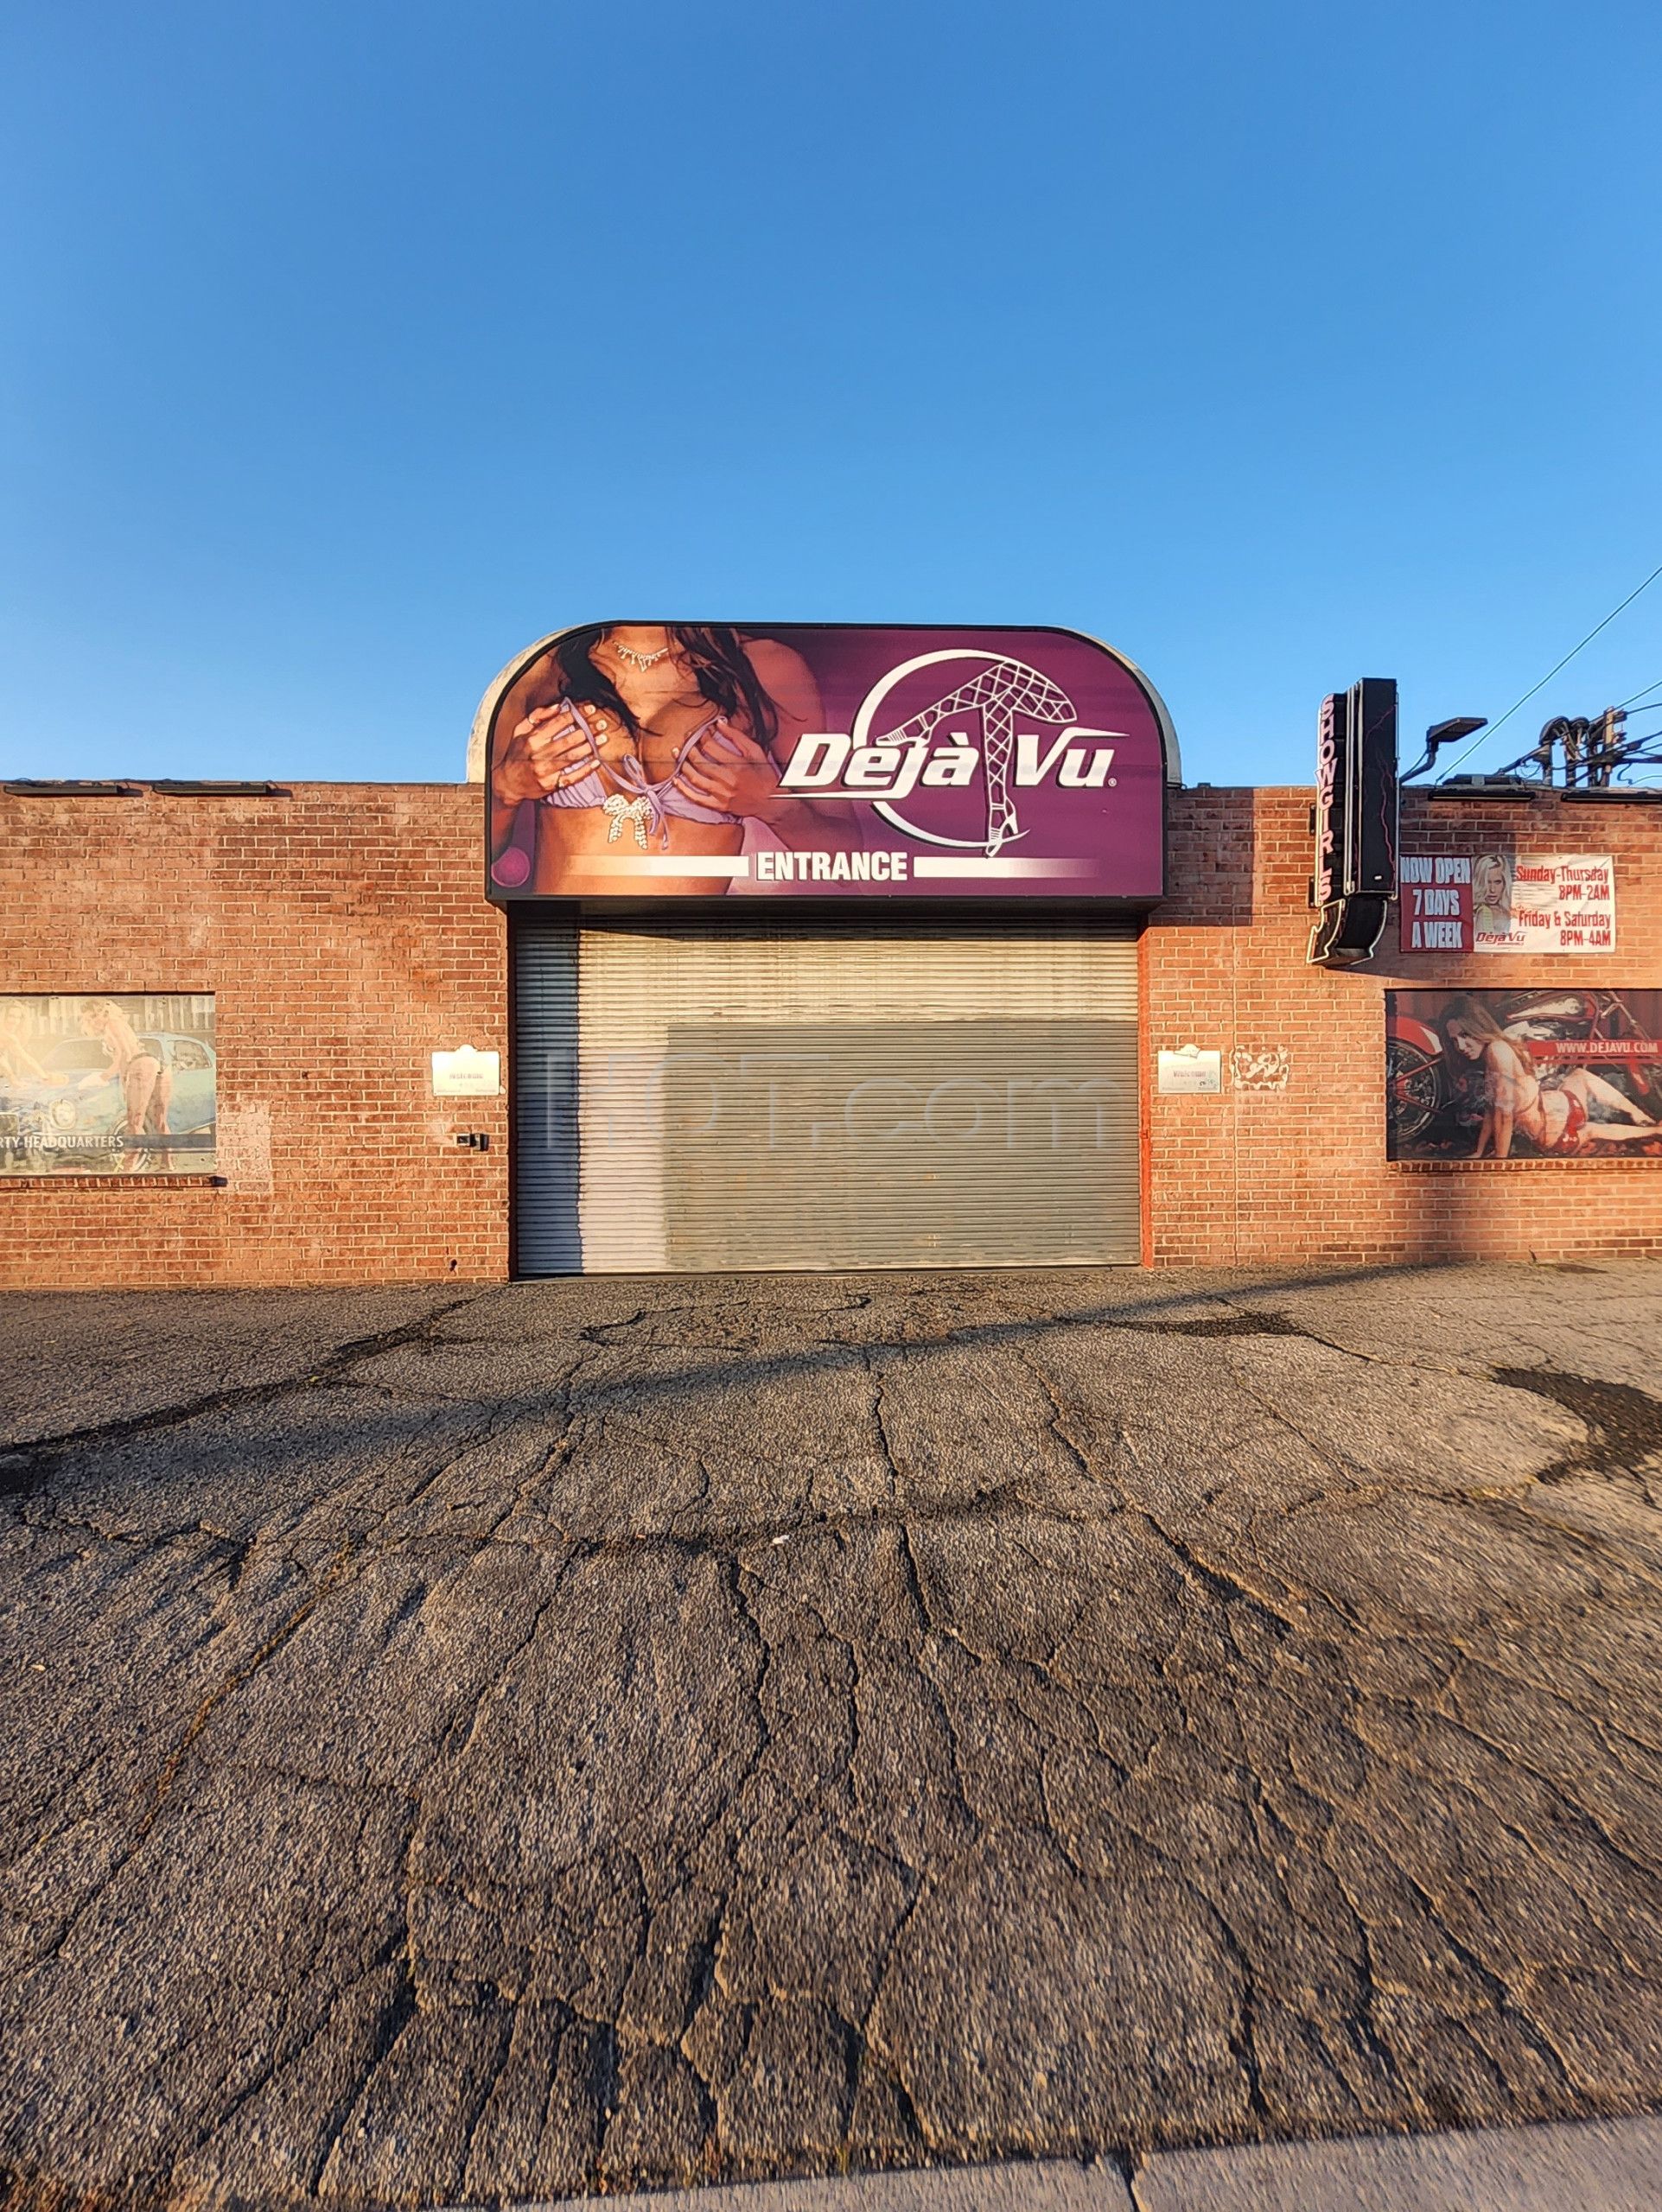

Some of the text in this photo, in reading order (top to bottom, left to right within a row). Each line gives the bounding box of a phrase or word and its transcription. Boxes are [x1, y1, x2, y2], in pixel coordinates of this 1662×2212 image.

[1315, 694, 1337, 901] SHOWGIRLS
[757, 851, 907, 881] ENTRANCE
[1400, 857, 1472, 884] NOW OPEN
[1516, 865, 1609, 884] Sunday-Thursday
[1558, 885, 1610, 900] 8PM-2AM
[1412, 889, 1460, 916] 7 DAYS
[1519, 910, 1611, 929] Friday & Saturday
[1411, 921, 1462, 949] A WEEK
[1560, 930, 1611, 946] 8PM-4AM
[1557, 1042, 1658, 1053] WWW.DEJAVU.COM
[24, 1135, 124, 1148] HEADQUARTERS
